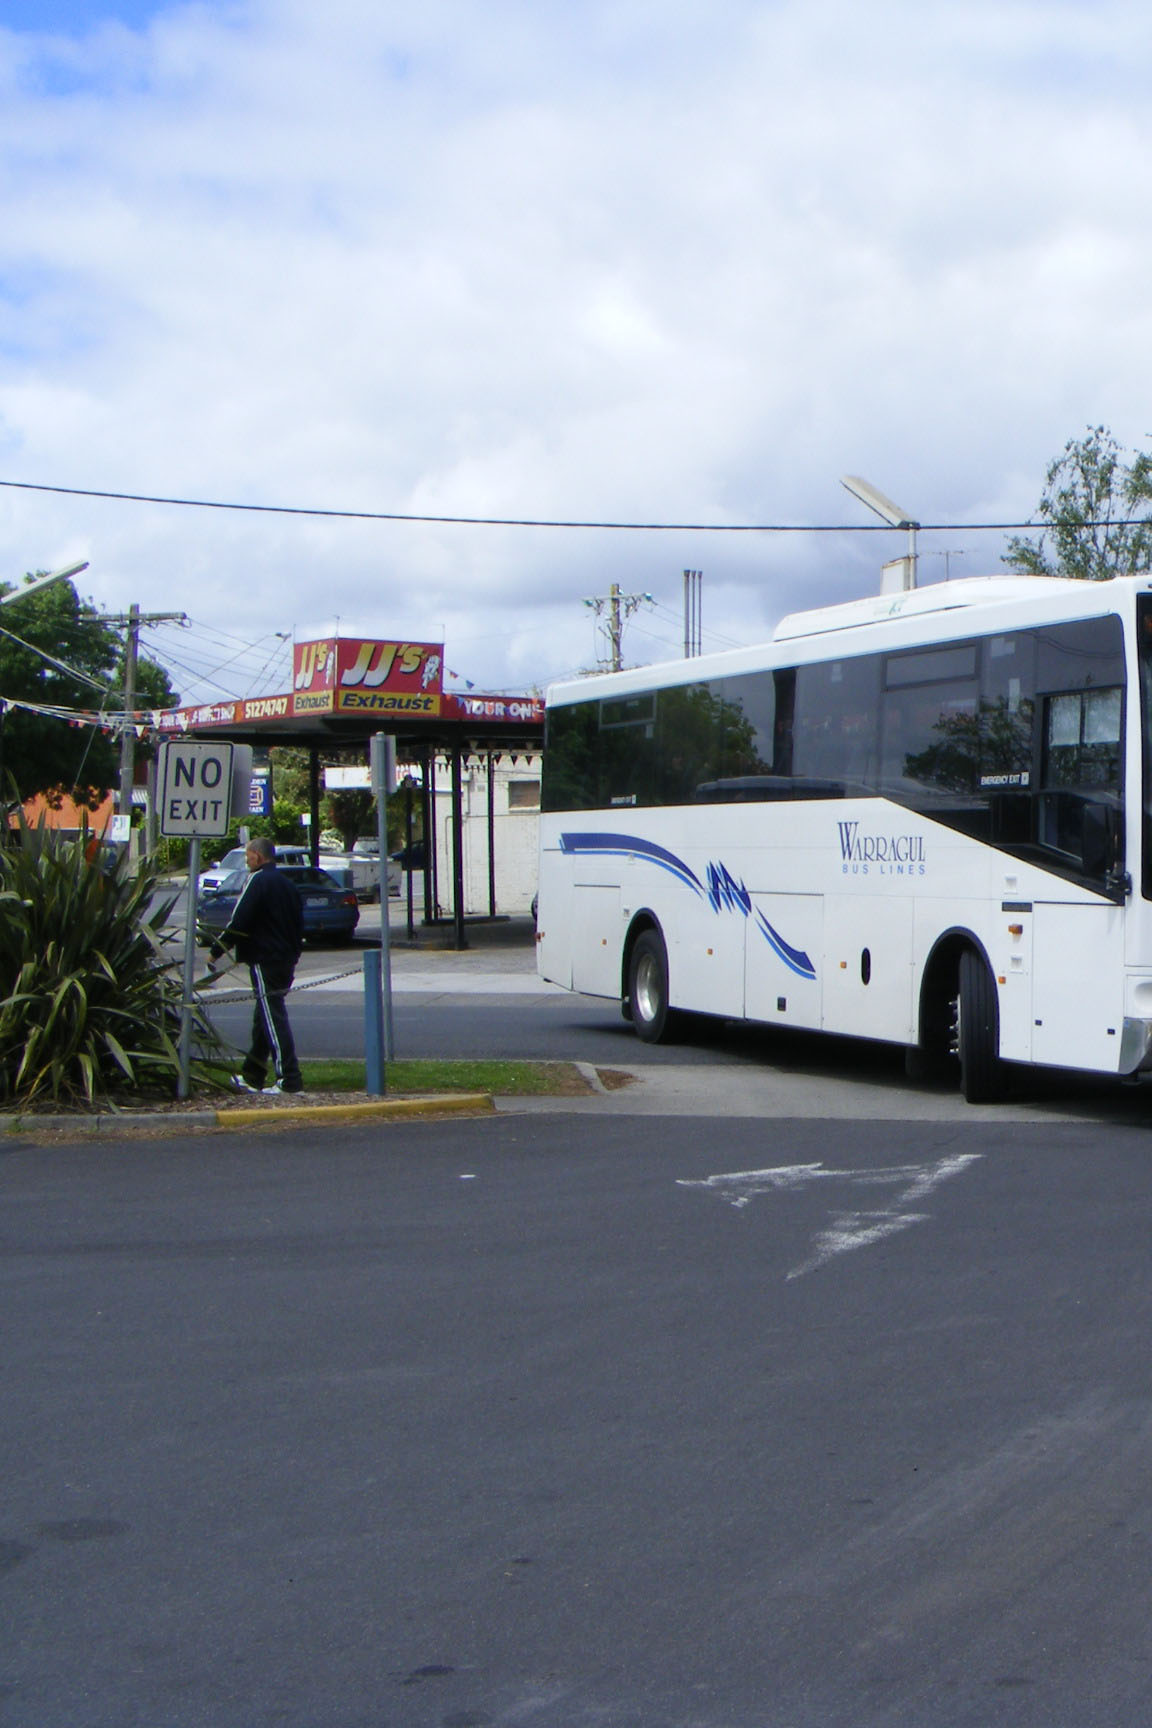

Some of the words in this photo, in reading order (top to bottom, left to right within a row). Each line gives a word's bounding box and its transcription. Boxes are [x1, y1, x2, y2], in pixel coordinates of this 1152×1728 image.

[245, 698, 288, 719] 51274747
[295, 693, 330, 710] Exhaust
[342, 693, 434, 711] Exhaust
[464, 700, 505, 716] YOUR
[174, 757, 222, 788] NO
[169, 800, 222, 821] EXIT
[842, 864, 869, 874] BUS
[880, 864, 926, 875] LINES
